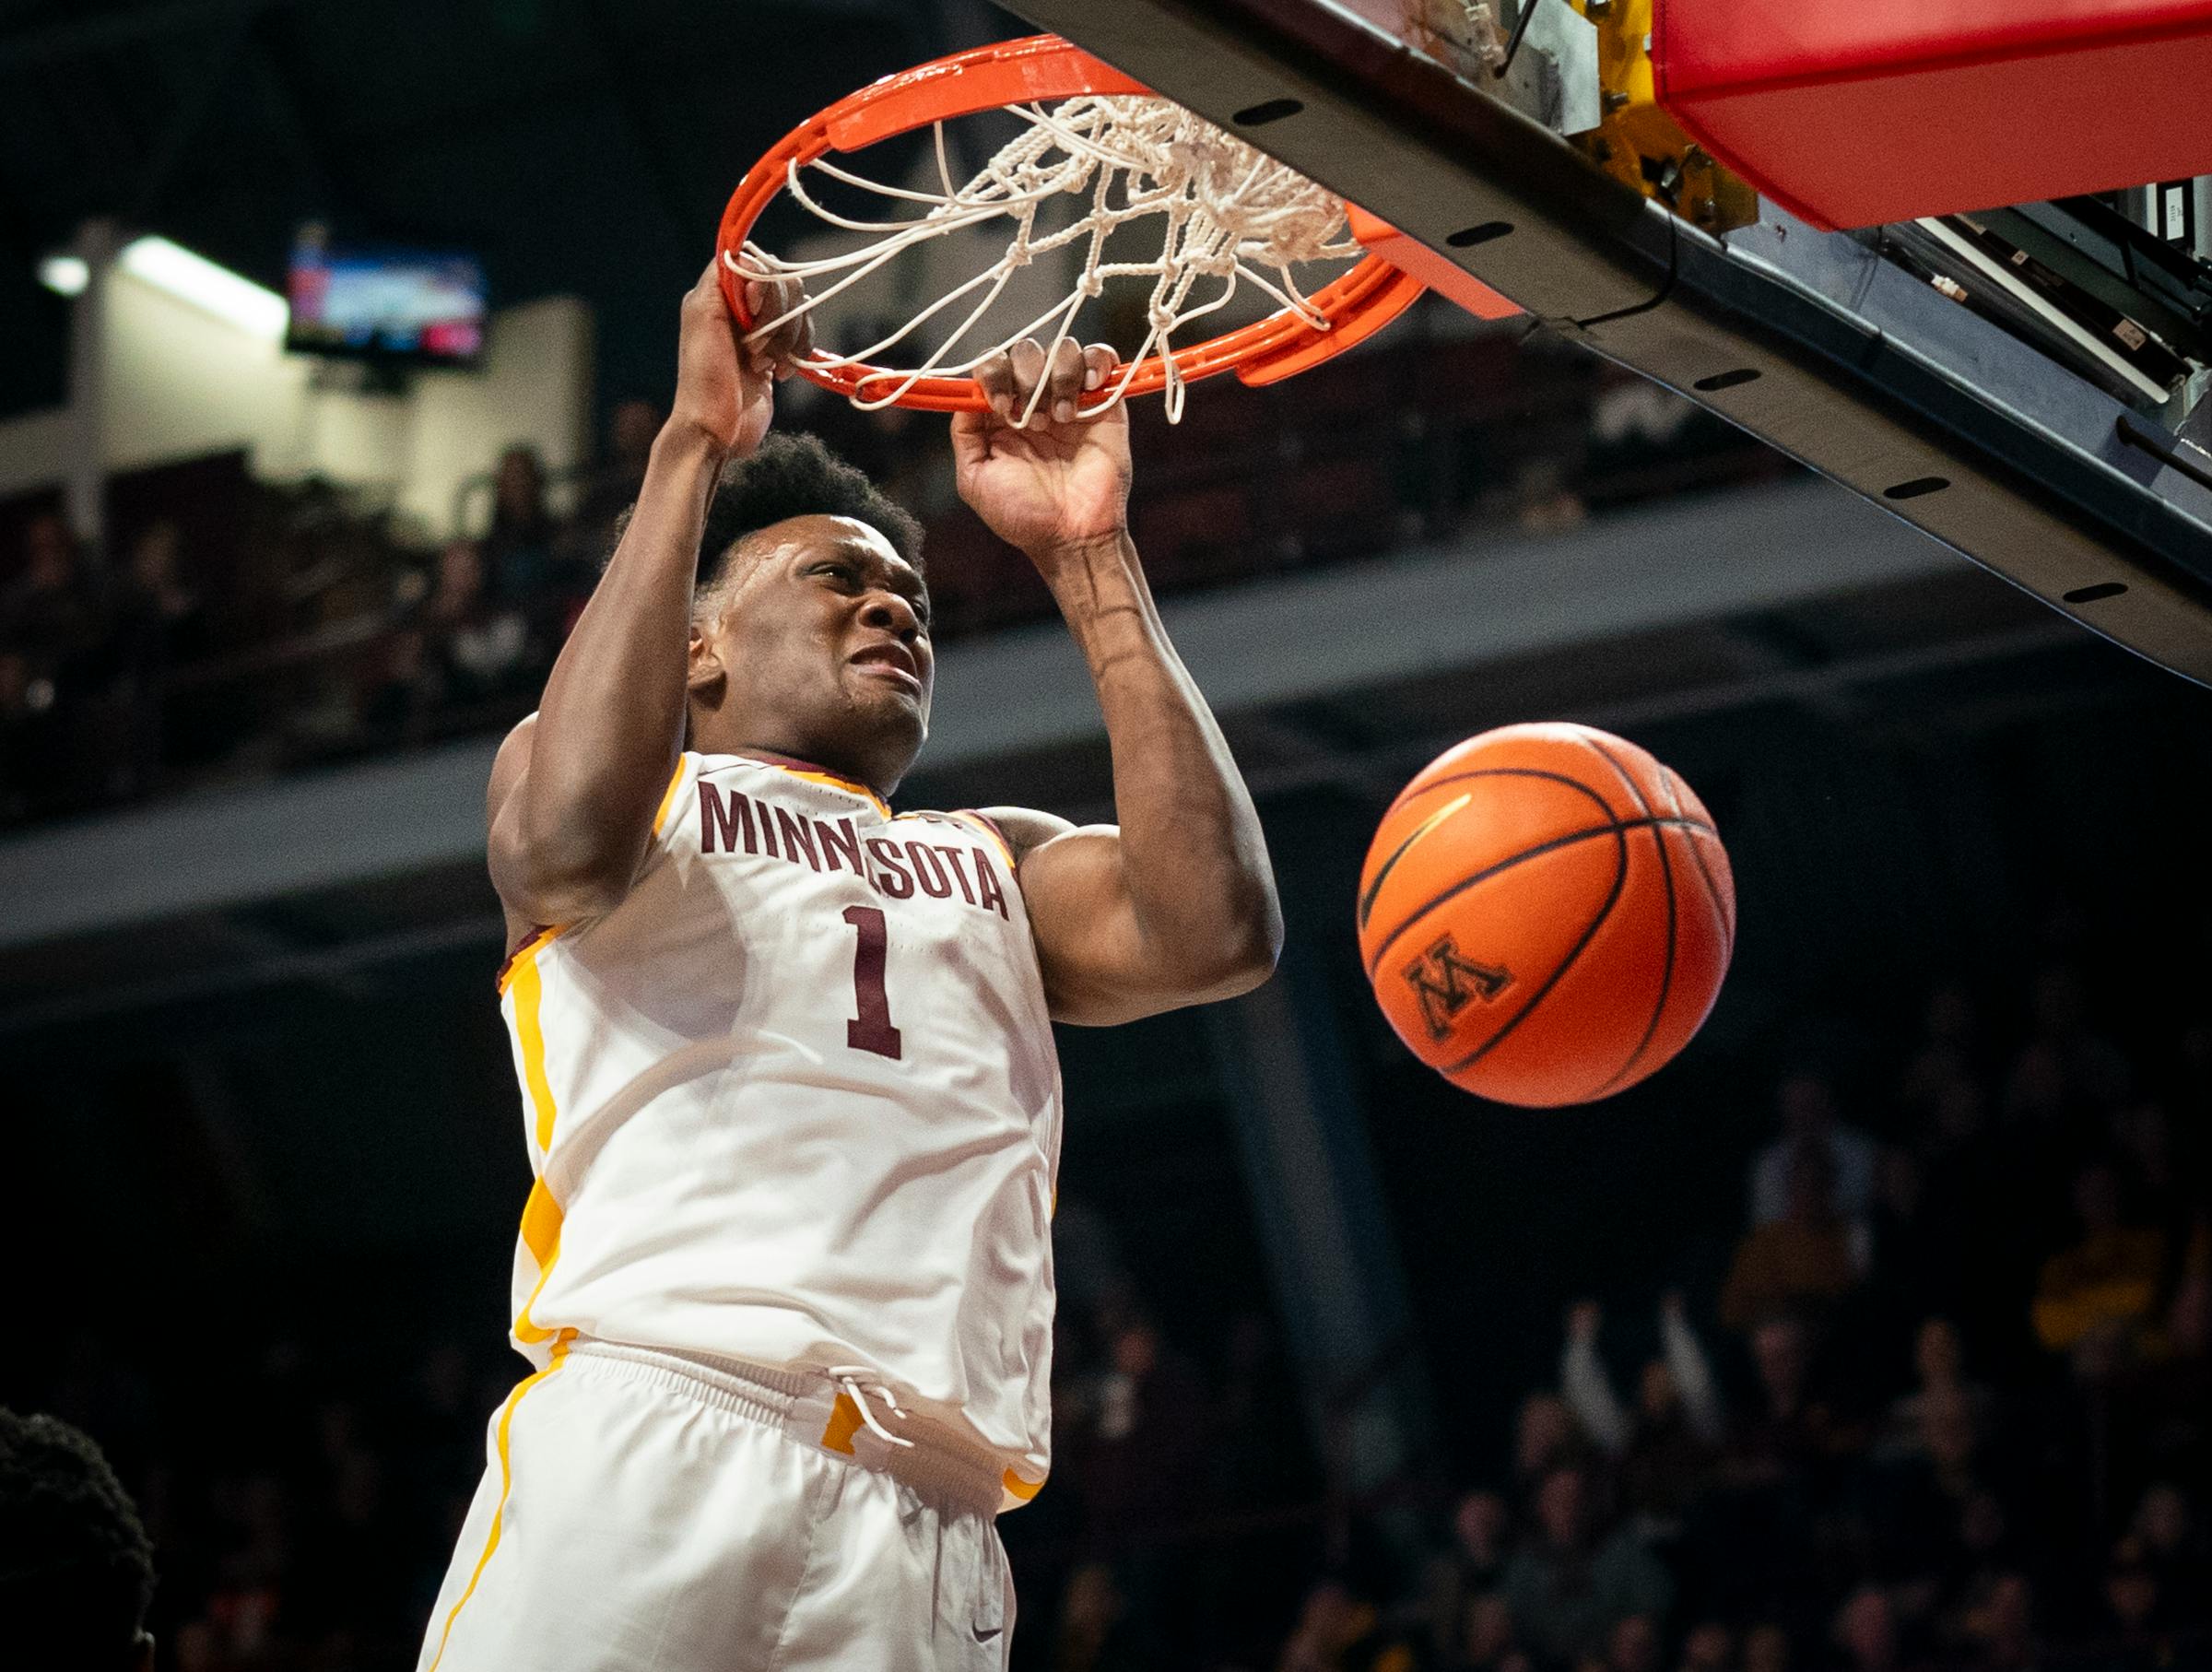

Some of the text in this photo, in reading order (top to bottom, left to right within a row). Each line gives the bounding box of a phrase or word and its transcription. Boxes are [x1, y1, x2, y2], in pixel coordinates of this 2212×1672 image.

[698, 781, 1010, 922] MINNSOTA
[842, 906, 901, 1060] 1
[1403, 932, 1514, 1043] M
